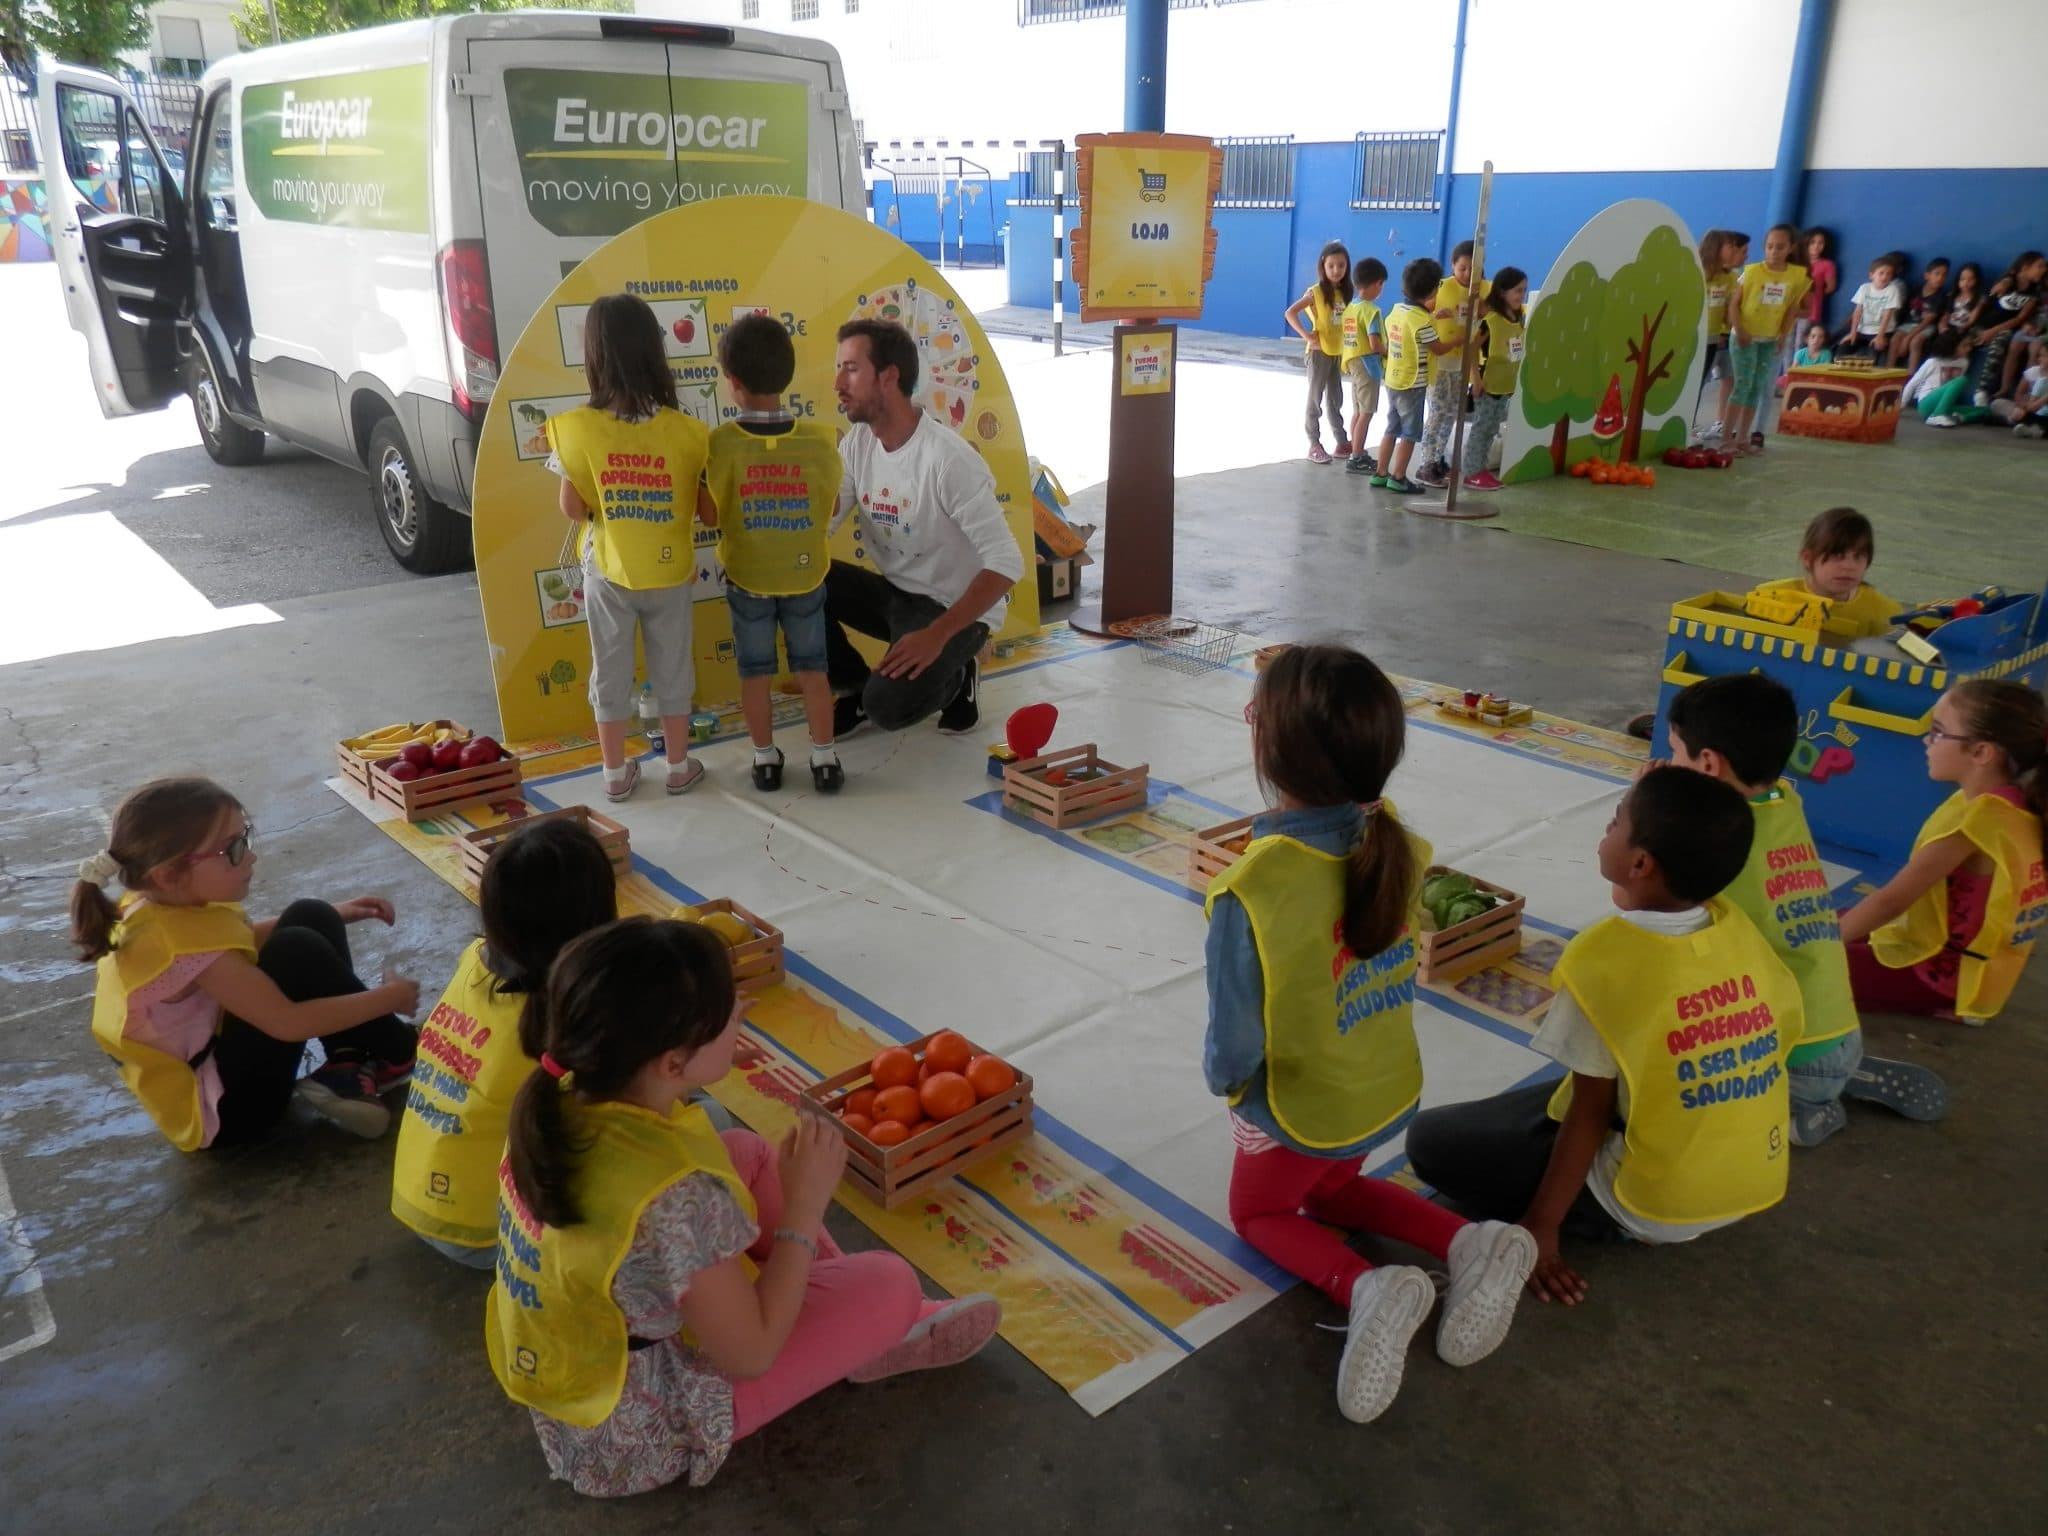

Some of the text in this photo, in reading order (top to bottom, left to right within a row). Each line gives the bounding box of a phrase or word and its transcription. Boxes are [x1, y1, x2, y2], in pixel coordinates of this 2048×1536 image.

[281, 90, 373, 155] Europcar
[553, 97, 768, 161] Europcar
[272, 174, 385, 217] moving your way
[529, 175, 651, 210] moving
[660, 181, 727, 209] your
[1131, 222, 1170, 241] LOJA
[625, 278, 739, 295] PEQUENO-ALMOÇO
[600, 470, 673, 488] APRENDER
[607, 453, 665, 471] ESTOU A
[746, 464, 801, 479] ESTOU A
[604, 489, 673, 503] A SER MAIS
[739, 481, 809, 497] APRENDER
[742, 499, 752, 513] A
[754, 500, 777, 512] SER
[605, 504, 674, 523] SAUDÁVEL
[1766, 843, 1809, 871] ESTOU
[1776, 904, 1790, 923] A
[1788, 896, 1817, 918] SER
[1343, 961, 1371, 995] SER
[1371, 937, 1416, 976] MAIS
[1336, 972, 1416, 1036] SAUDÁV
[1676, 974, 1757, 1021] ESTOU A
[429, 1001, 492, 1050] ESTOU A
[1666, 1001, 1774, 1056] APRENDER
[1677, 1029, 1779, 1082] A SER MAIS
[431, 1069, 471, 1104] MAIS
[1679, 1061, 1782, 1109] SAUDÁVEL
[406, 1085, 464, 1136] UDÁVEL
